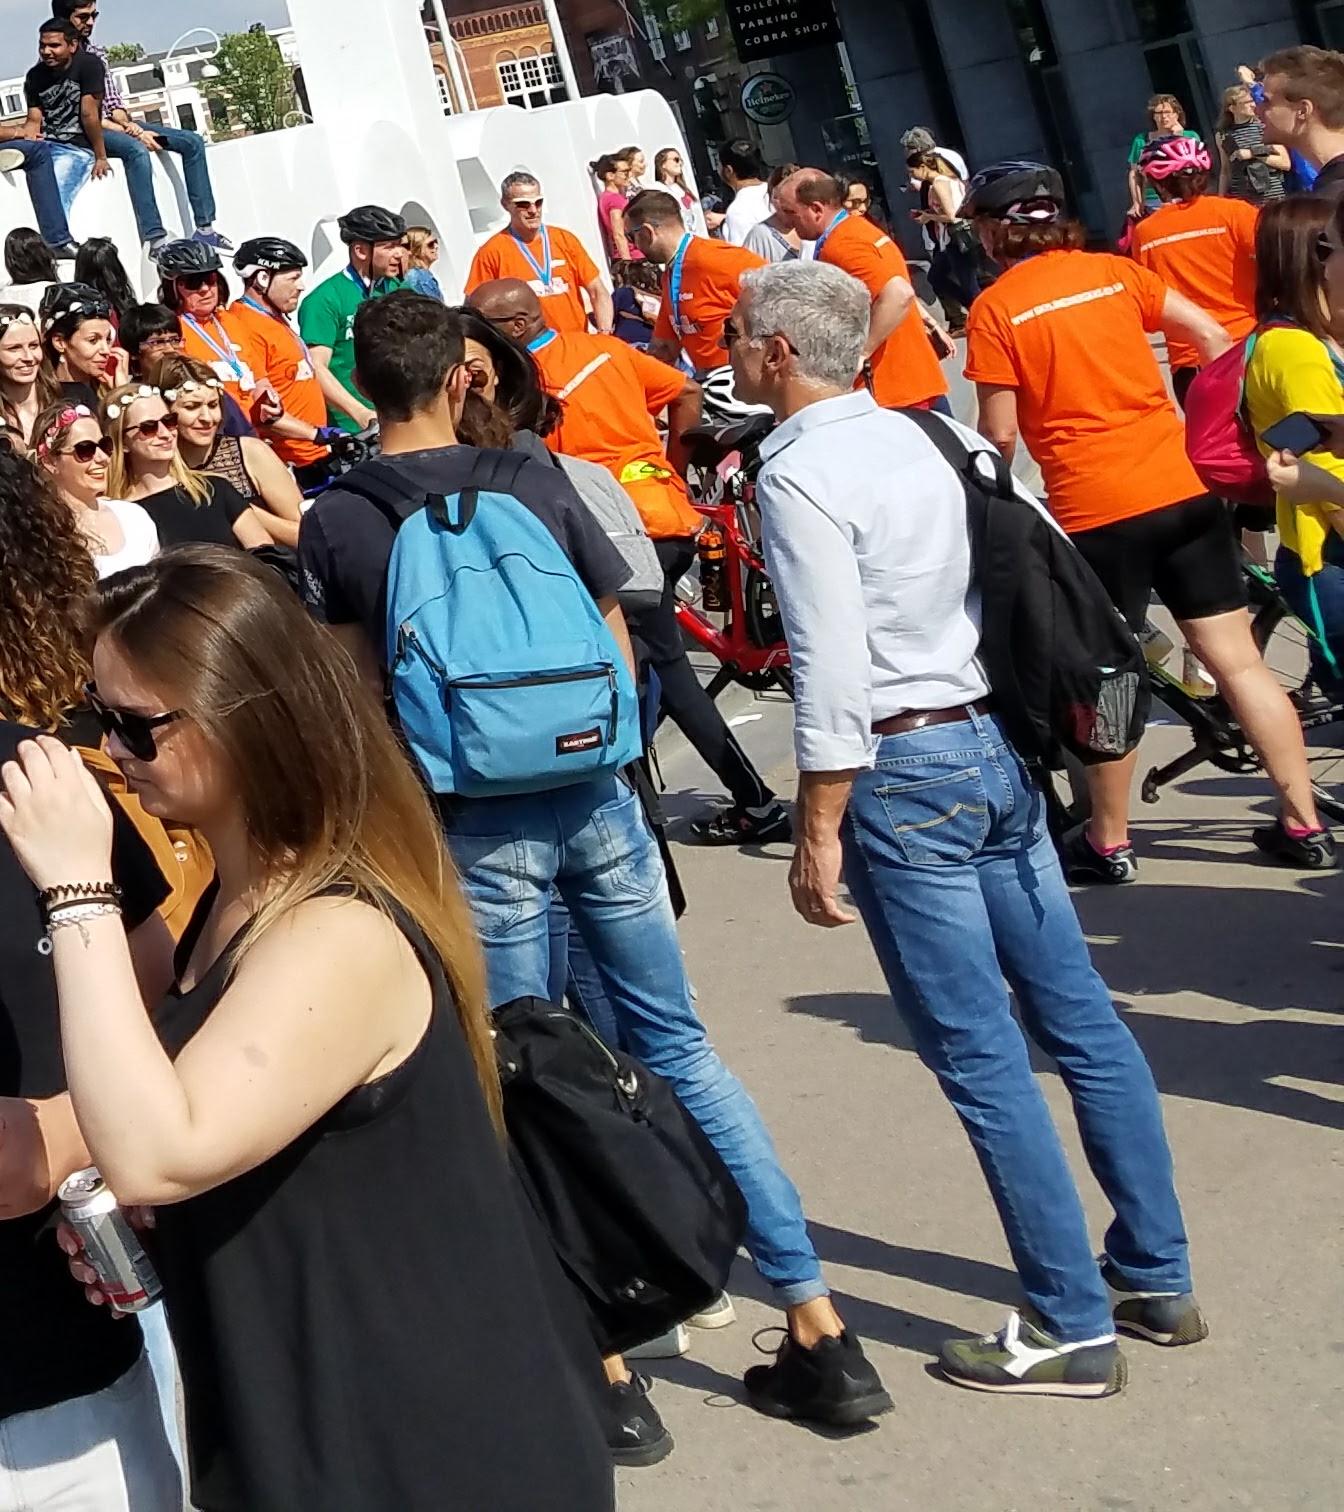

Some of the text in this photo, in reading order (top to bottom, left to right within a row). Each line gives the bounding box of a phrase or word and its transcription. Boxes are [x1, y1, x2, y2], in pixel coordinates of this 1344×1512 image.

[739, 11, 798, 31] PARKING
[744, 21, 829, 47] COBRA SHOP
